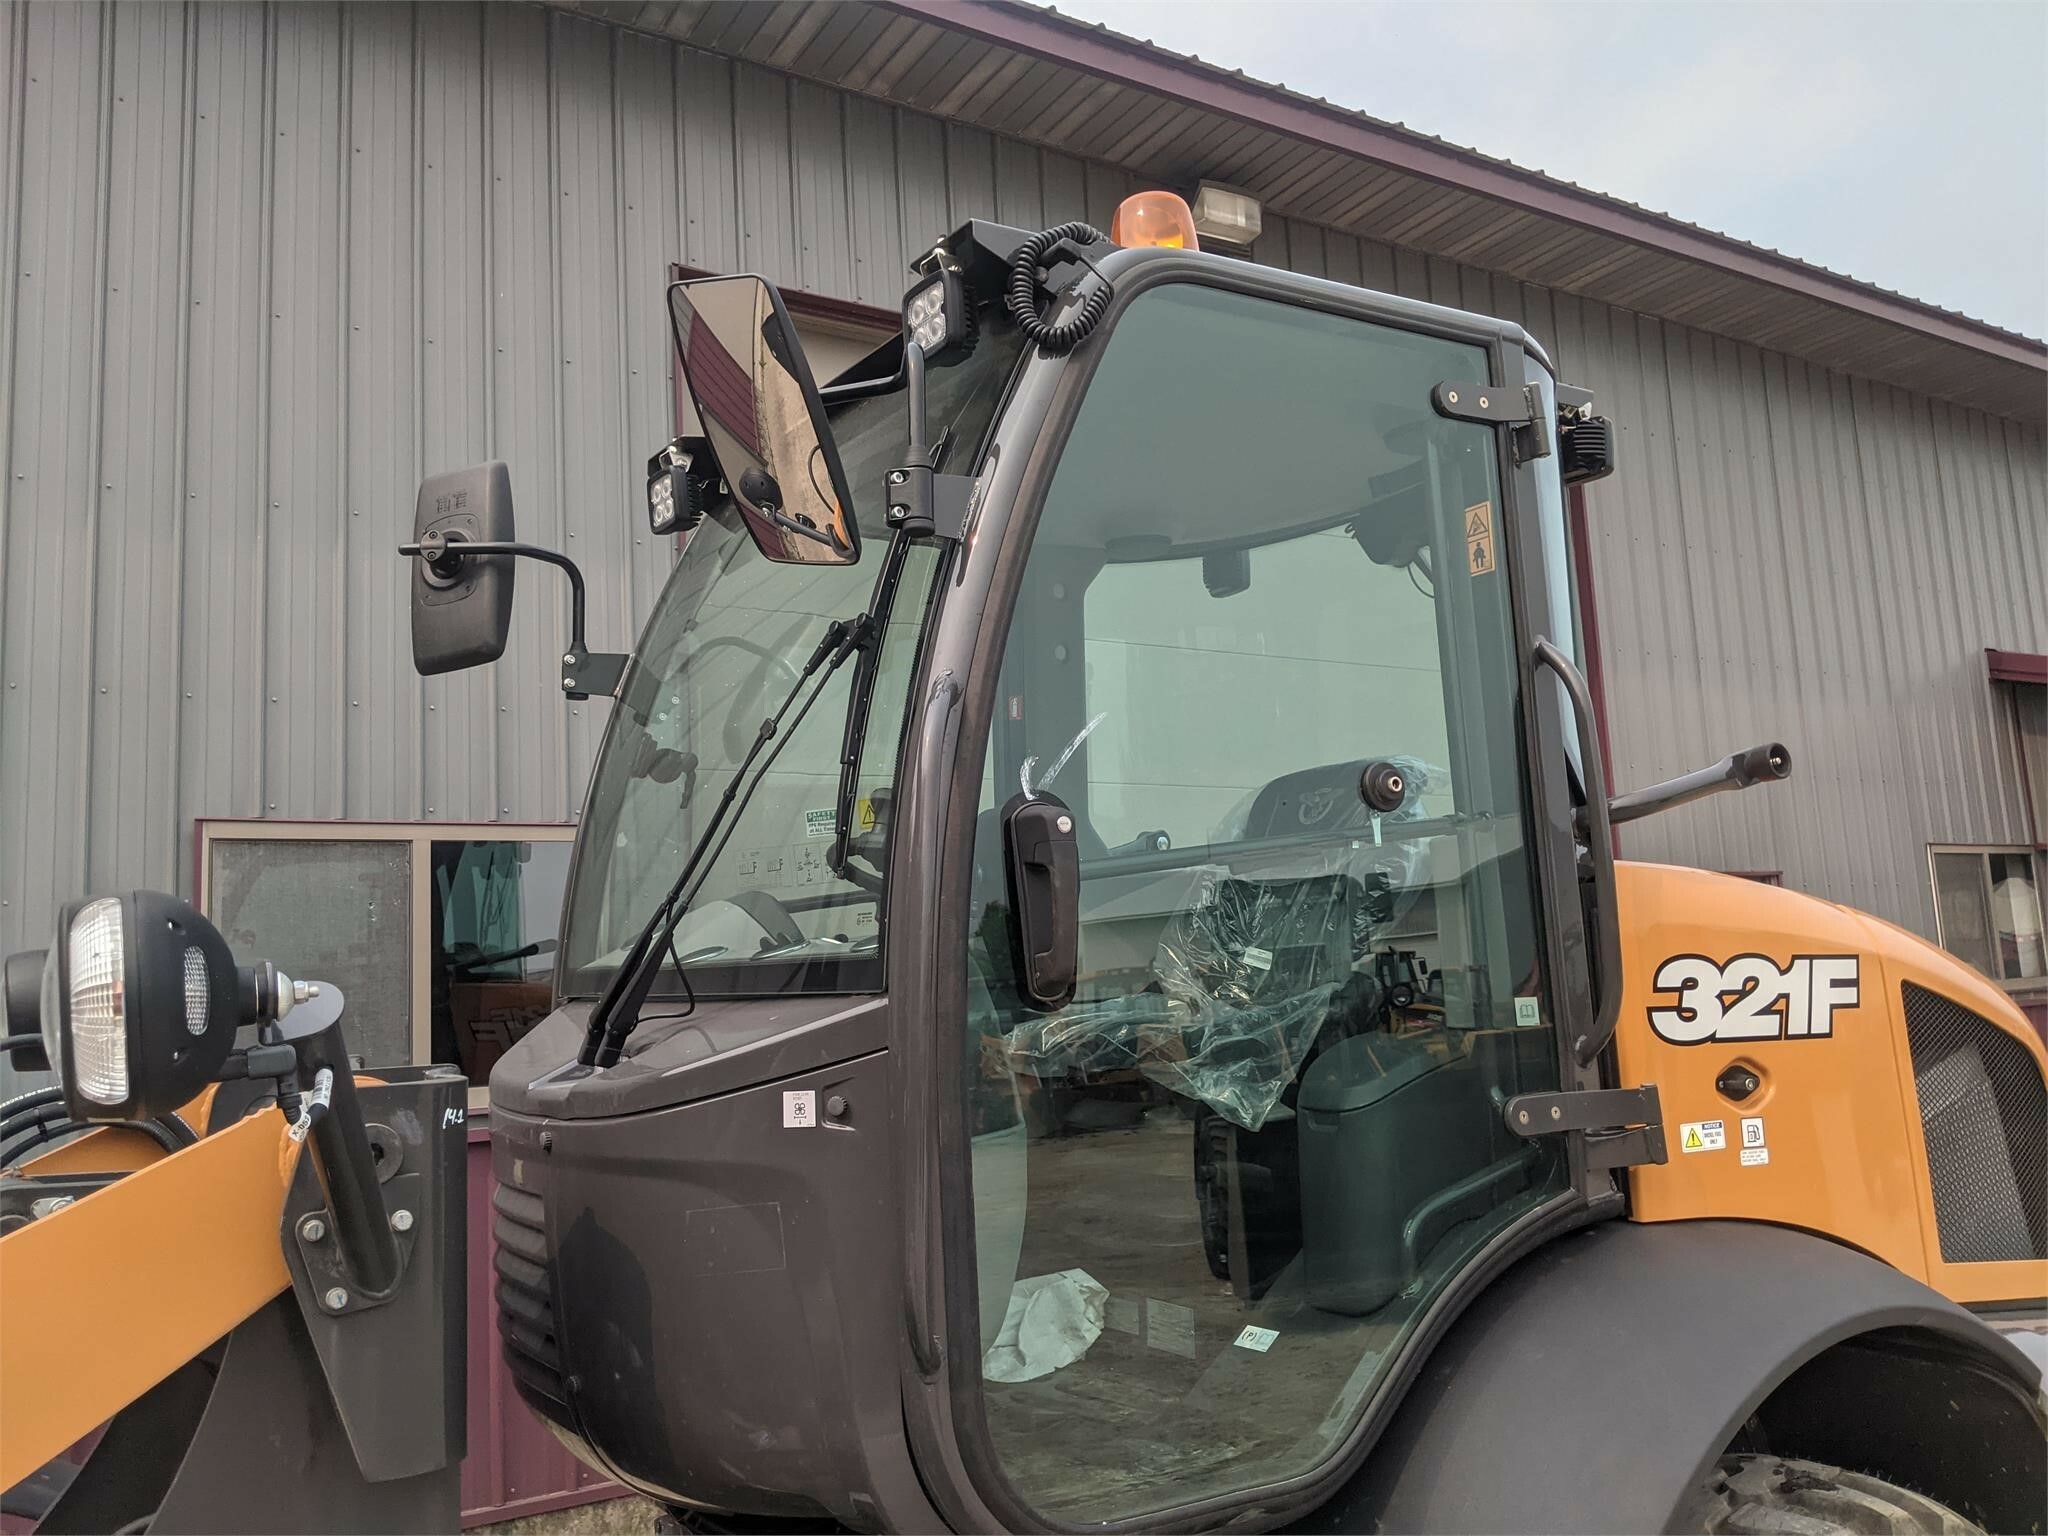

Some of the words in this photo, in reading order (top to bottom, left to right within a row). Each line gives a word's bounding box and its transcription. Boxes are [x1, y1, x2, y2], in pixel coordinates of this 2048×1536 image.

[808, 810, 835, 819] SAFETY
[1646, 953, 1861, 1047] 321F
[1704, 1122, 1721, 1130] NOTICE
